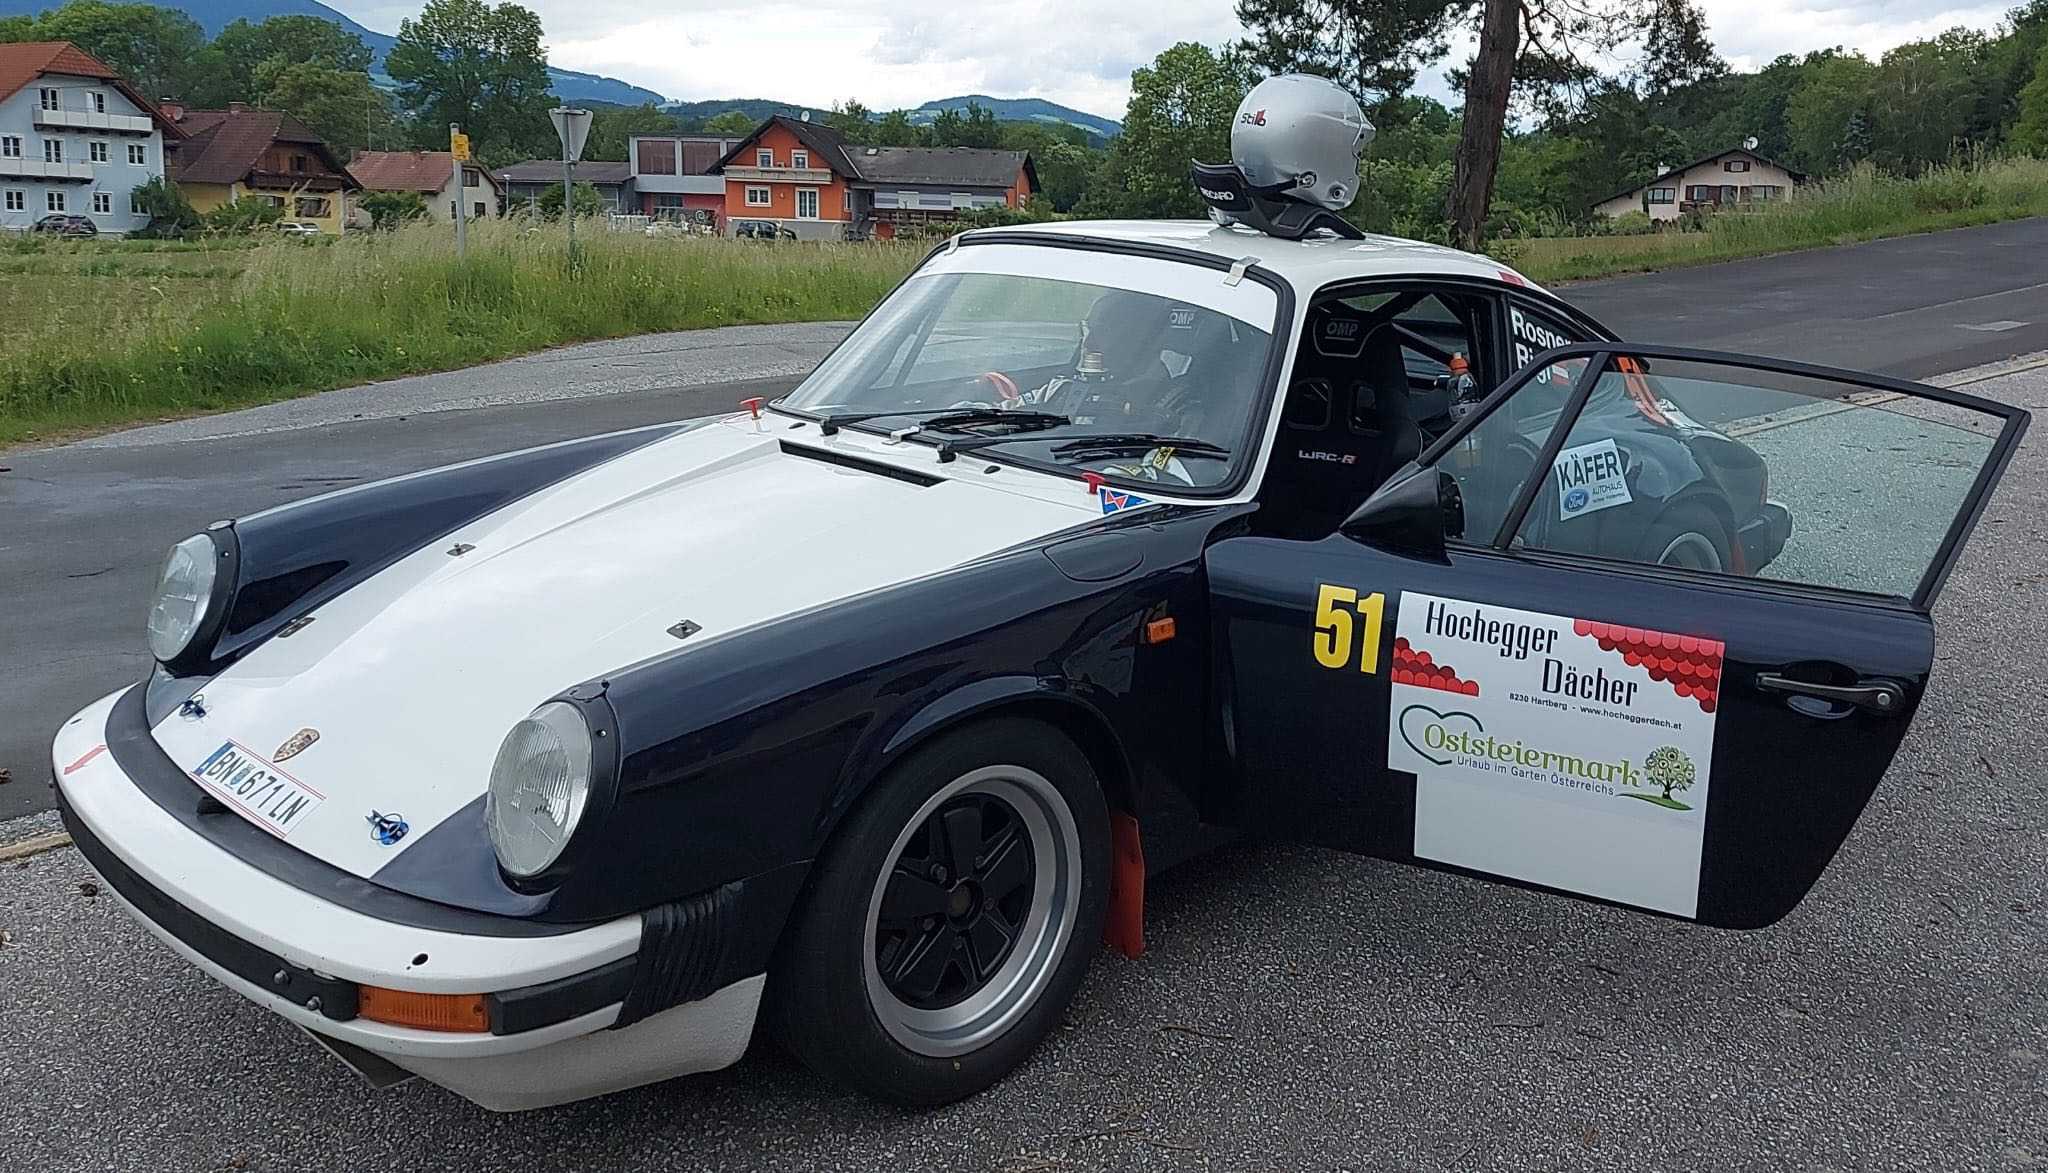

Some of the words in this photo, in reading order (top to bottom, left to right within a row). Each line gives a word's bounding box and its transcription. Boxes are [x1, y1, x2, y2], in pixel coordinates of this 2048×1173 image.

[1170, 312, 1194, 325] OMP
[1327, 321, 1358, 336] OMP
[1299, 450, 1356, 464] WRC-R
[1558, 451, 1619, 491] KÄFER
[1592, 480, 1624, 496] AUTOHAUS
[1313, 583, 1385, 675] 51
[1425, 601, 1559, 660] Hochegger
[1542, 658, 1638, 707] Dächer
[1509, 692, 1529, 703] 8230
[1531, 695, 1568, 711] Hartberg
[1580, 705, 1682, 731] www.hocheggerdach.at
[1424, 723, 1641, 788] Oststeiermark
[206, 751, 246, 783] BN
[237, 770, 285, 809] 671
[268, 790, 311, 825] LN
[1457, 756, 1491, 771] Urlaub
[1494, 763, 1507, 774] im
[1511, 766, 1546, 782] Garten
[1551, 771, 1614, 796] Österreichs
